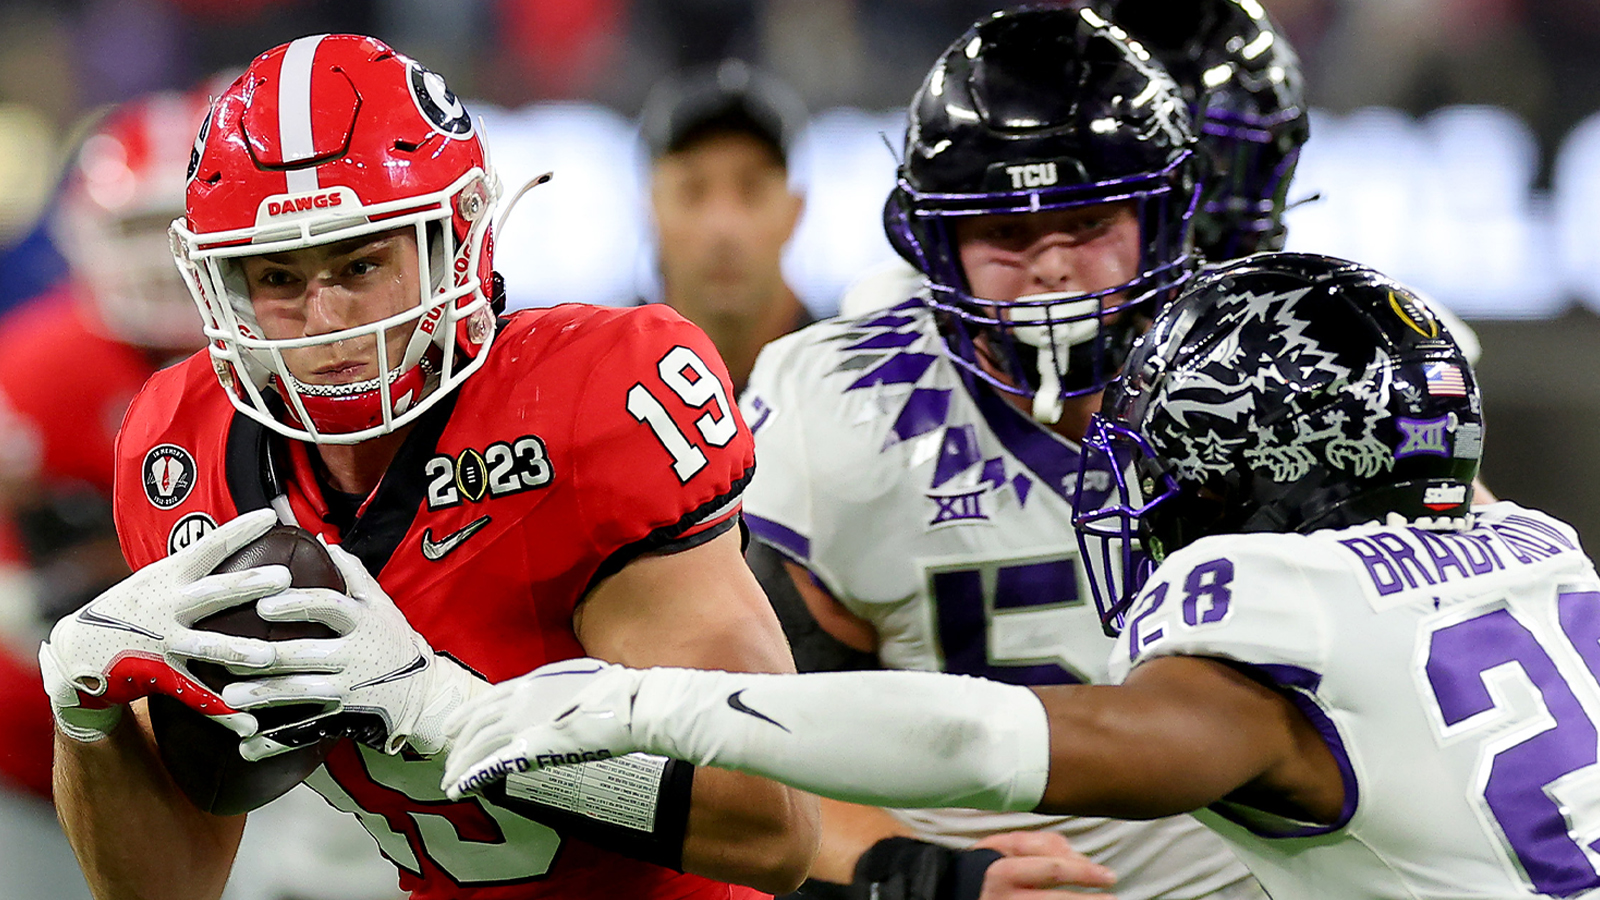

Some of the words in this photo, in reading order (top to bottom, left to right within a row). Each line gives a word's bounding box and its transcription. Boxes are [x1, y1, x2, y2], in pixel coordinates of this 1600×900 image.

[1006, 163, 1058, 190] TCU
[268, 191, 342, 217] DAWGS
[626, 344, 738, 485] 19
[160, 448, 184, 459] MEMORY
[926, 491, 989, 527] XII
[1129, 557, 1235, 663] 28
[458, 756, 531, 795] HORNED
[535, 749, 613, 769] FROGS
